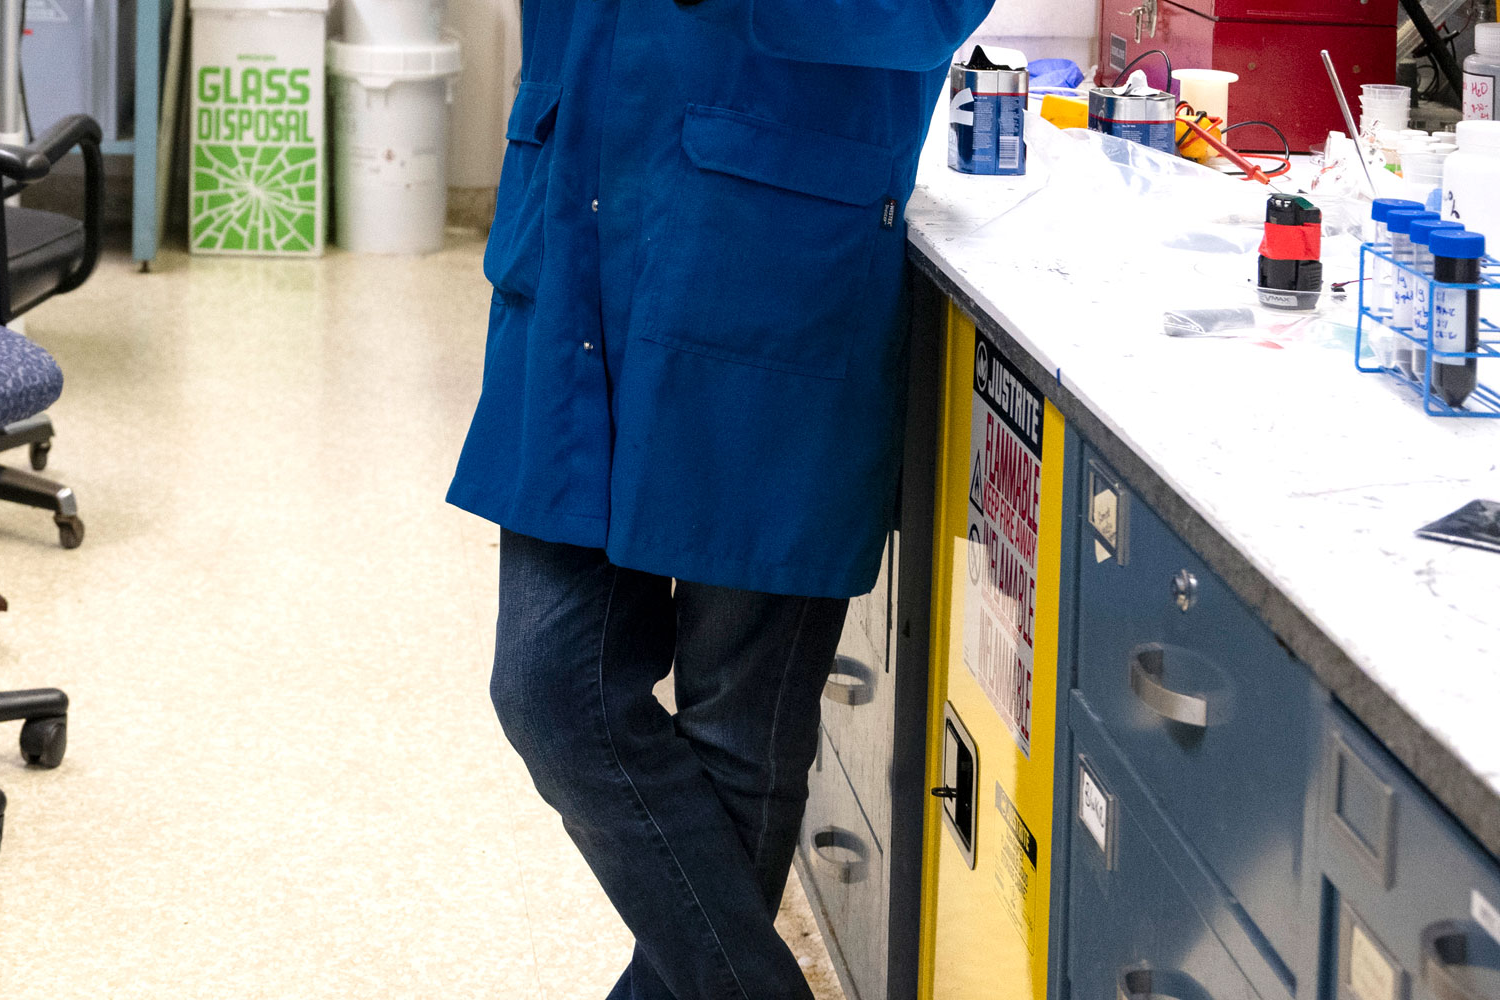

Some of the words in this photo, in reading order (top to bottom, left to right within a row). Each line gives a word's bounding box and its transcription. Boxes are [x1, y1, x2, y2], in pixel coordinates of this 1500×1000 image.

[198, 67, 310, 105] GLASS
[198, 107, 314, 143] DISPOSAL
[988, 357, 1040, 445] JUSTRITE
[984, 411, 1040, 536] FLAMMABLE
[983, 477, 999, 524] KEEP
[1000, 497, 1014, 545] FIRE
[1015, 516, 1037, 570] AWAY
